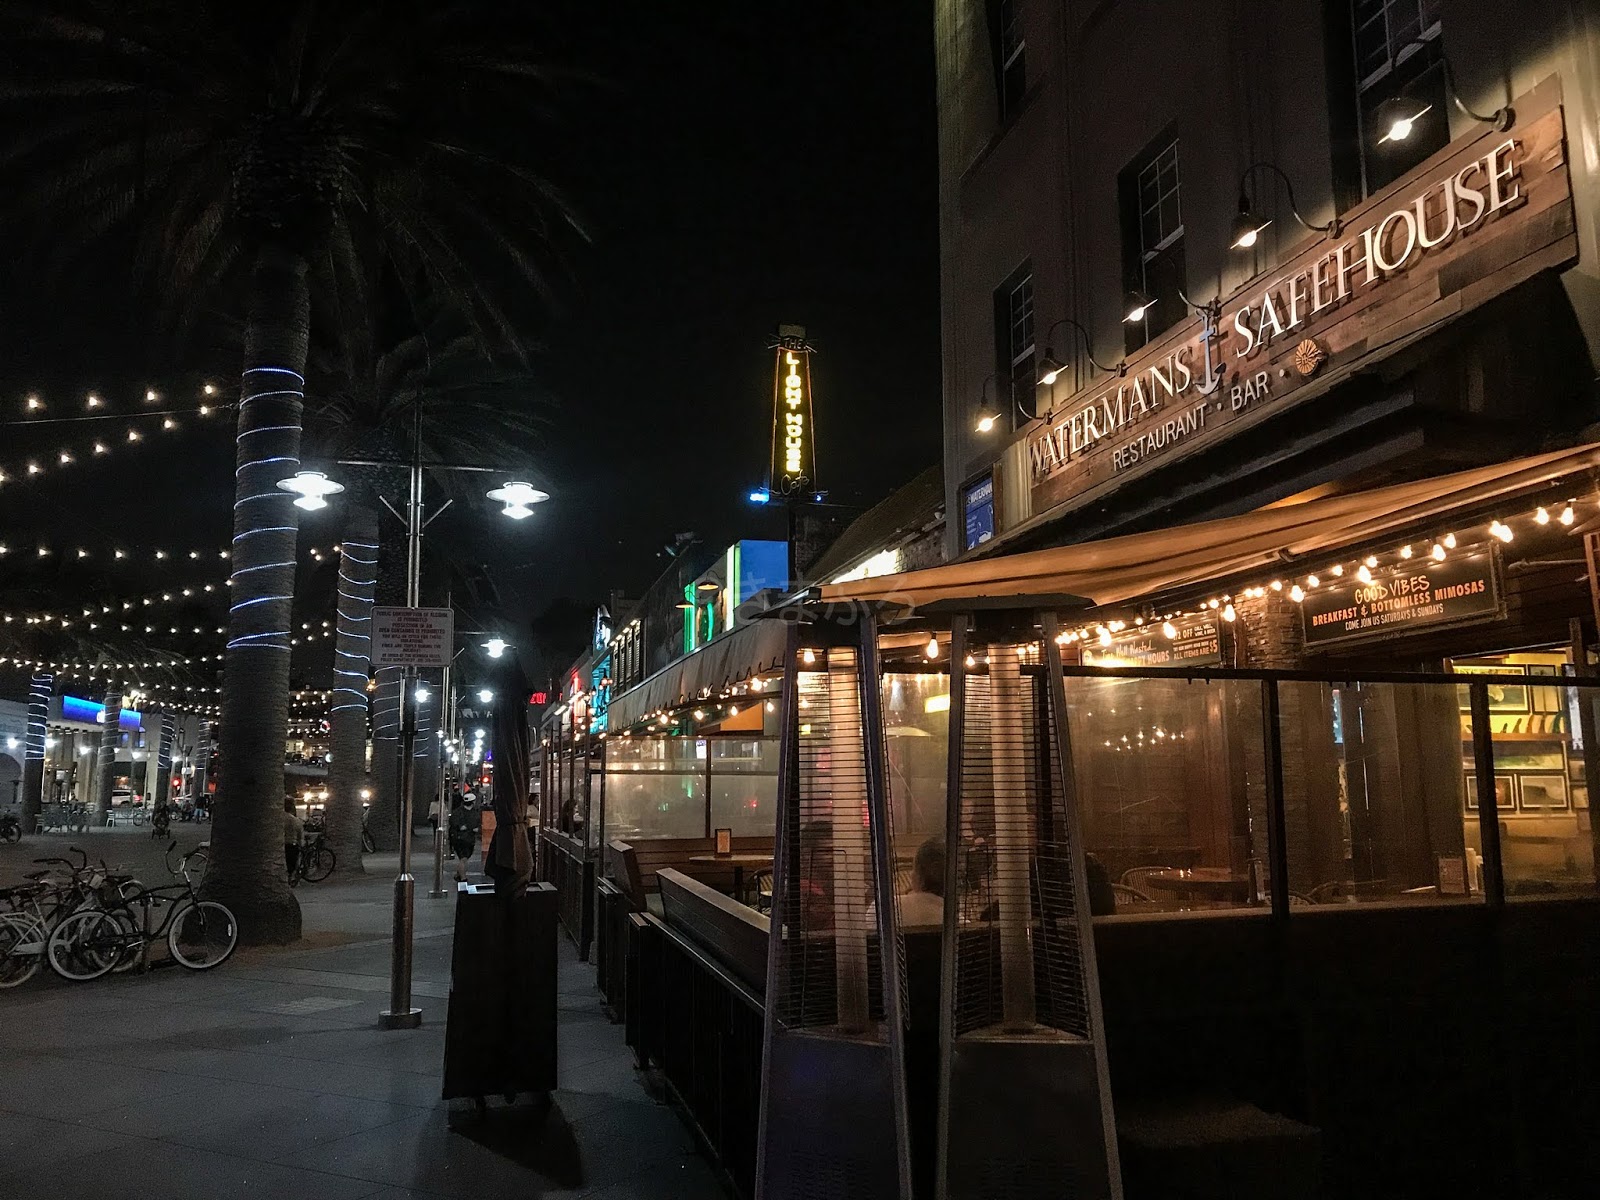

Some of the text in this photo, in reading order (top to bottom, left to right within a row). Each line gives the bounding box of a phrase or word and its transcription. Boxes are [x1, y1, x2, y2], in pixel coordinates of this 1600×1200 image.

[1029, 138, 1520, 472] WATERMANS SAFEHOUSE
[1113, 371, 1269, 471] RESTAURANT BAR
[1312, 580, 1485, 627] BREAKFAST & BOTTOMLESS MIMOSAS
[1355, 574, 1430, 605] GOOD VIBES
[1345, 619, 1360, 631] COME
[1360, 617, 1372, 628] JOIN
[1372, 615, 1380, 626] US
[1380, 609, 1411, 625] SATURDAYS
[1417, 603, 1444, 618] SUNDAYS
[1182, 628, 1193, 639] OFF
[1148, 650, 1170, 665] HOURS
[1173, 639, 1218, 660] ALL ITEMS ARE $5
